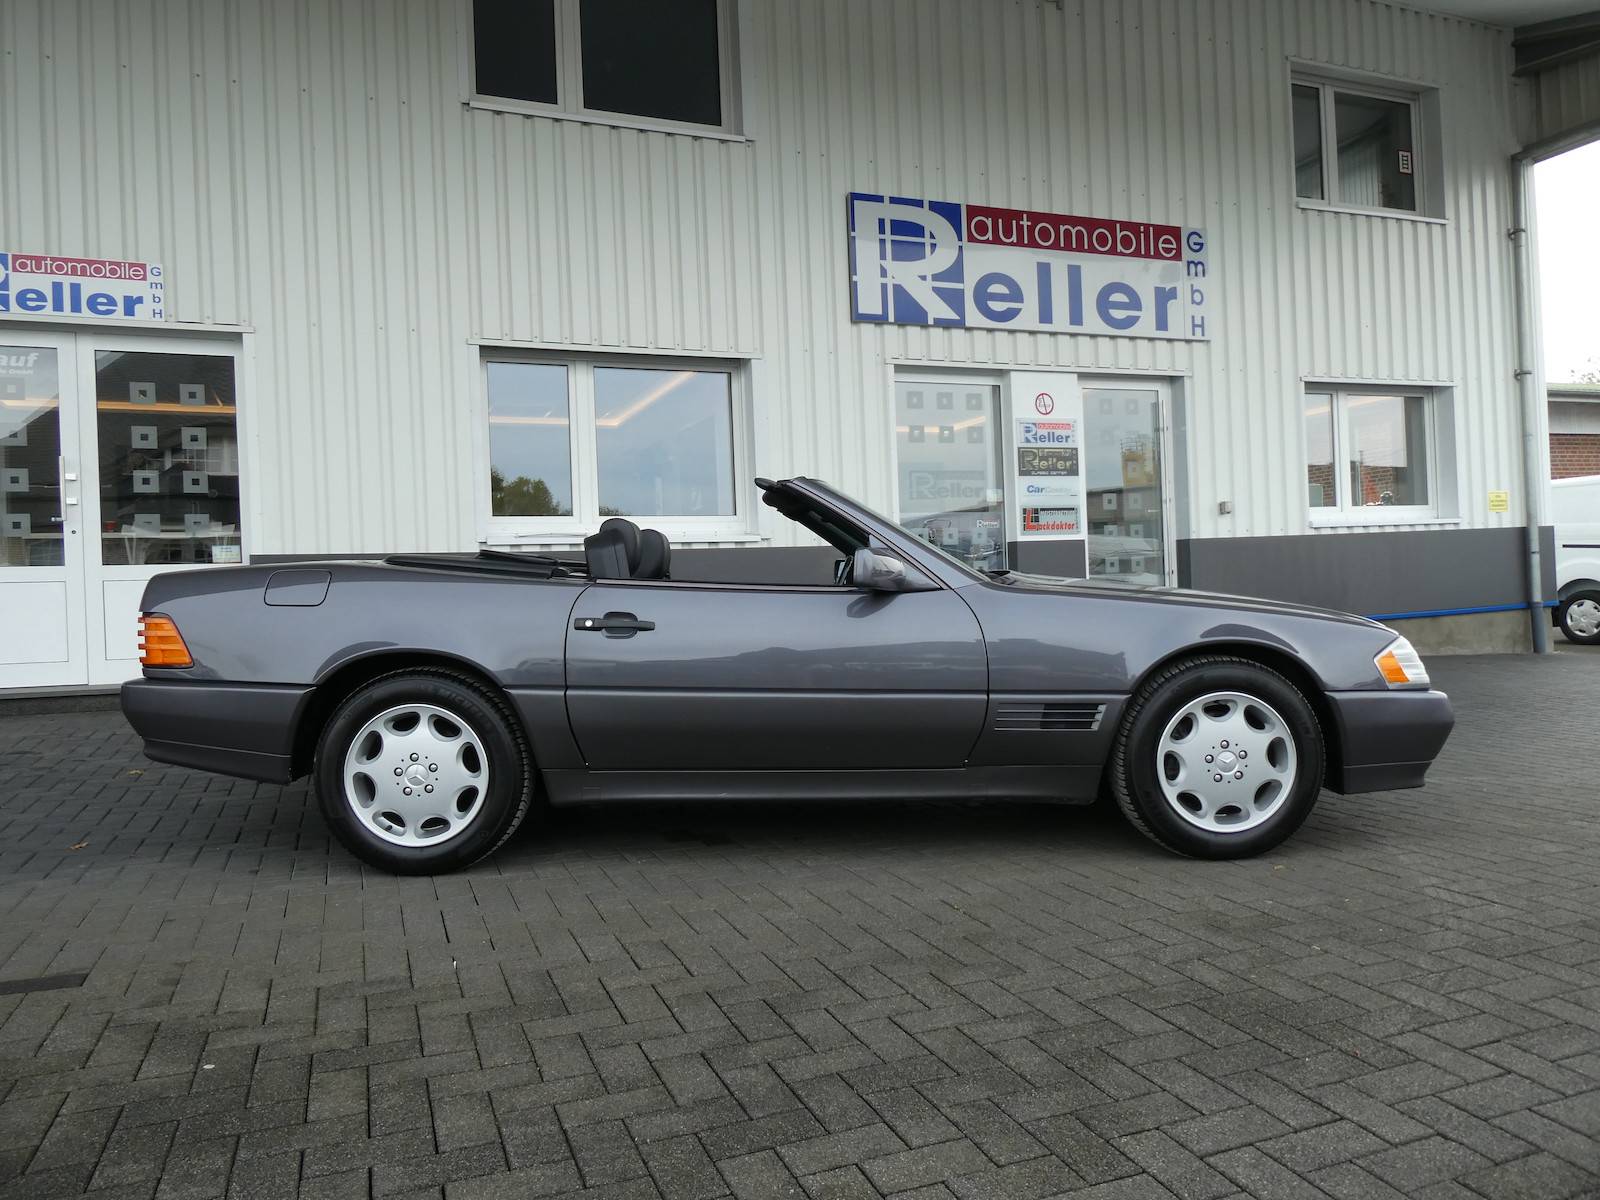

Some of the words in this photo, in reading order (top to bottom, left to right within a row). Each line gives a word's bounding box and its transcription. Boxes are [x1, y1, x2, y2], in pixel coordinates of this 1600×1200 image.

[970, 213, 1178, 257] automobile
[0, 262, 144, 317] eller
[15, 258, 145, 280] automobile
[852, 198, 1178, 332] Reller
[1186, 230, 1206, 337] GmbH
[150, 266, 163, 319] GmbH
[1023, 423, 1071, 443] Reller
